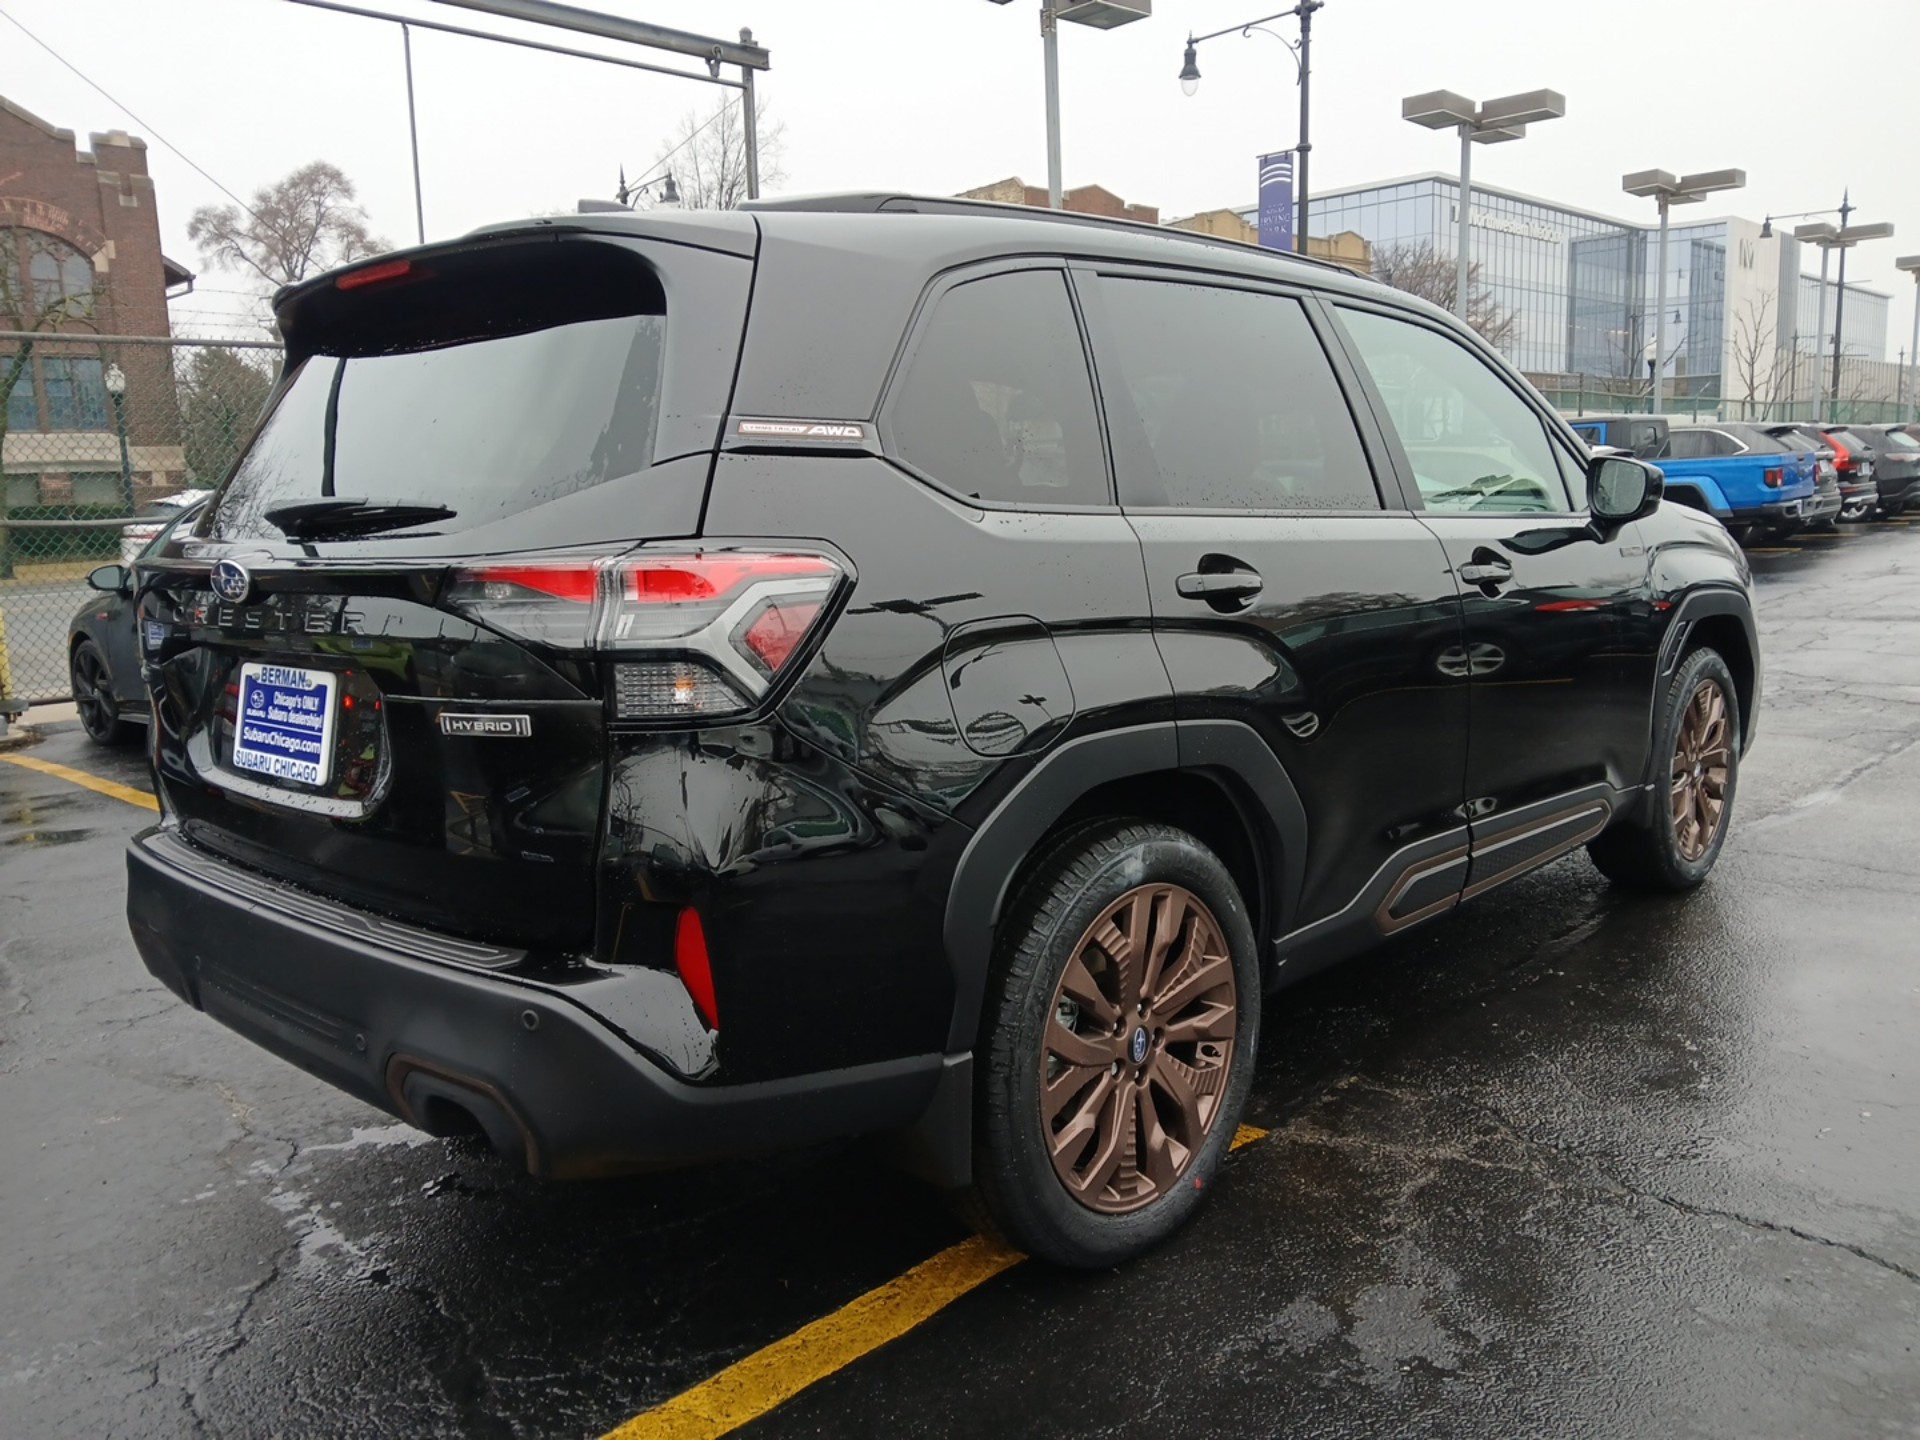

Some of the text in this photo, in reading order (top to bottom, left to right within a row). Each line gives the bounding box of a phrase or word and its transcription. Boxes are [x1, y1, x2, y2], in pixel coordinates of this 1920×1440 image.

[808, 425, 862, 437] AWD
[261, 667, 306, 688] BERMAN
[273, 691, 320, 711] Chicago's ONLY
[267, 706, 323, 731] Subaru dealership!
[452, 720, 513, 732] HYBRID
[243, 726, 321, 754] SubaruChicago.com
[235, 749, 318, 782] SUBARU CHICAGO
